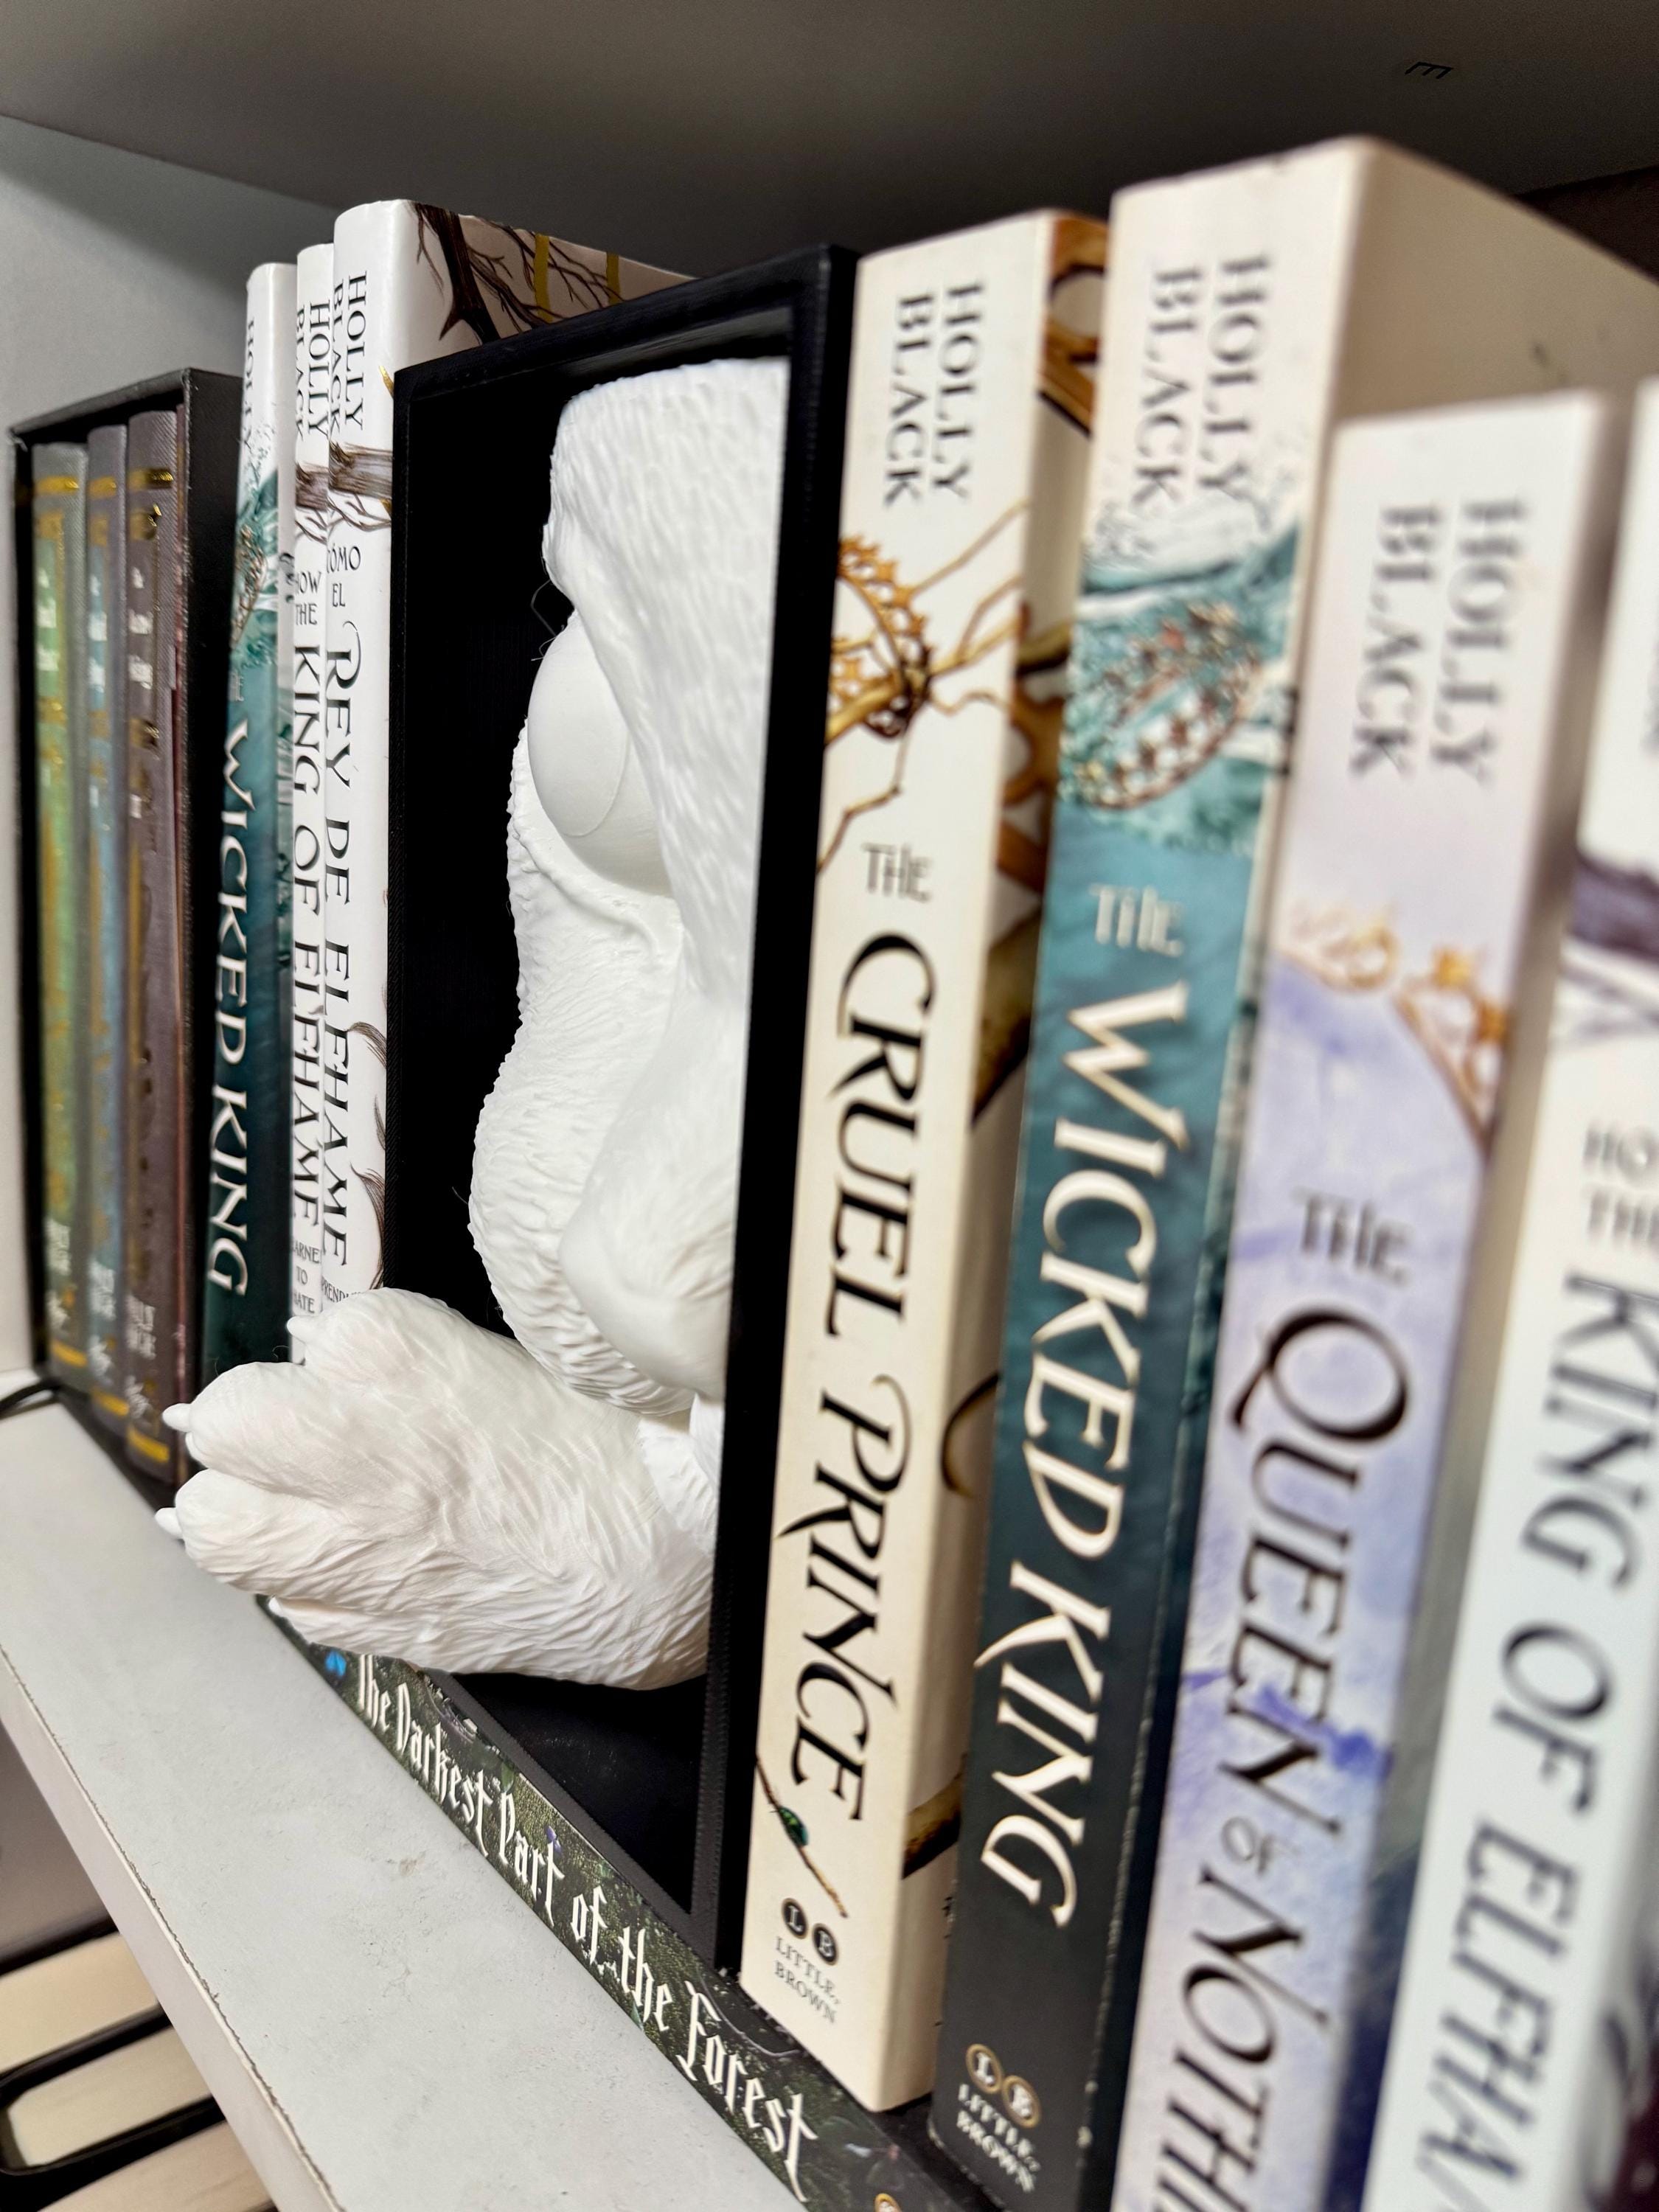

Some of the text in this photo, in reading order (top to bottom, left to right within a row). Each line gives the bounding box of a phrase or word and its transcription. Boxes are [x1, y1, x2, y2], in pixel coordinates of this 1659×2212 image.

[308, 299, 331, 438] HOLLY
[345, 271, 367, 431] HOLLY
[885, 291, 933, 509] BLACK
[931, 279, 982, 503] HOLLY
[1133, 262, 1205, 510] BLACK
[1200, 254, 1270, 501] HOLLY
[332, 582, 346, 608] EL
[1350, 502, 1440, 782] BLACK
[1429, 498, 1525, 786] HOLLY
[215, 718, 256, 1065] WICKED
[291, 645, 322, 1229] KING OF ELFHAME
[323, 621, 361, 1267] REY DE ELFHAME
[861, 842, 932, 901] THE
[207, 1082, 249, 1296] KING
[296, 1266, 308, 1284] TO
[1582, 1121, 1659, 1187] HO
[776, 931, 936, 1820] CRUEL PRINCE
[973, 980, 1190, 1929] WICKED KING
[1217, 1302, 1409, 1837] QUEEN
[1413, 1268, 1659, 2212] KING OF ELFHA
[358, 1654, 818, 2203] The Darkest Part of the Forest
[774, 1960, 837, 2024] BROWN
[775, 1935, 841, 2005] LITTLE,
[1152, 1863, 1329, 2212] NOTHI
